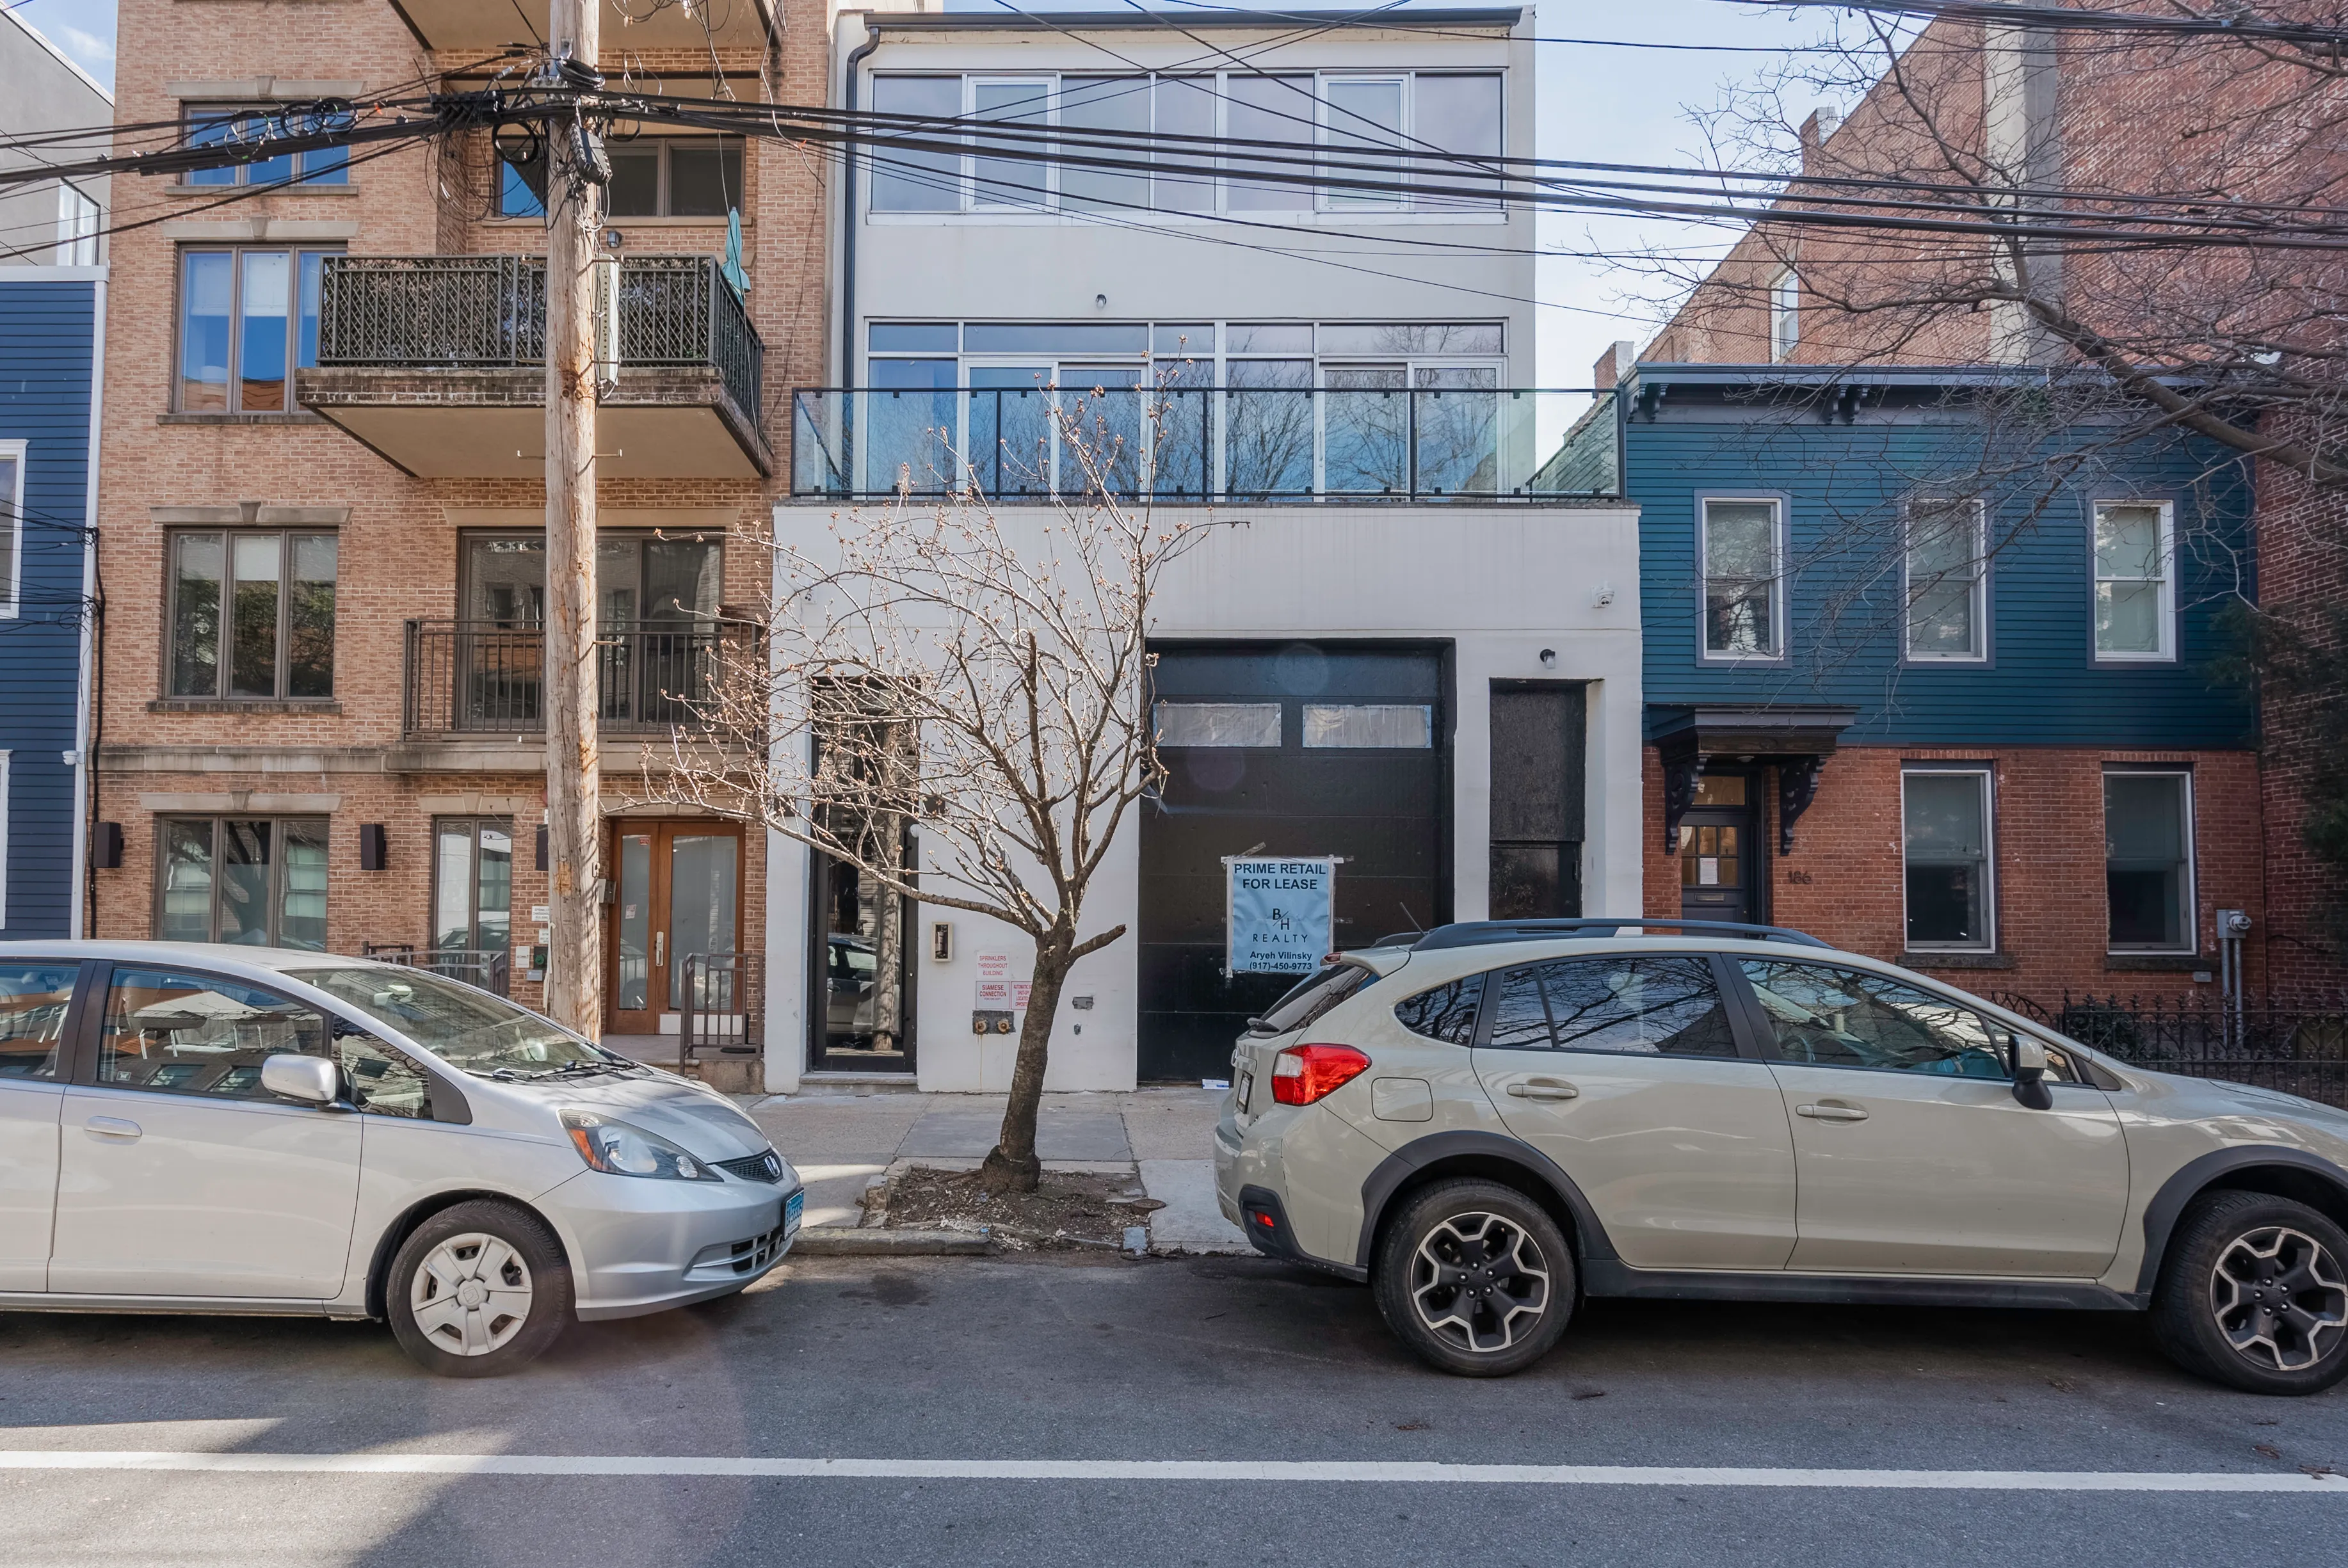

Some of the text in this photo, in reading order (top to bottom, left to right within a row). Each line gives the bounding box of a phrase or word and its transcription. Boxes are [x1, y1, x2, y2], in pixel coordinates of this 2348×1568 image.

[1234, 863, 1326, 875] PRIME RETAIL
[1788, 870, 1812, 884] 186
[1242, 879, 1317, 890] FOR LEASE
[1253, 934, 1308, 943] REALTY
[1250, 951, 1312, 961] Aryeh Vilinsky
[1250, 962, 1312, 970] (917)-450-9773
